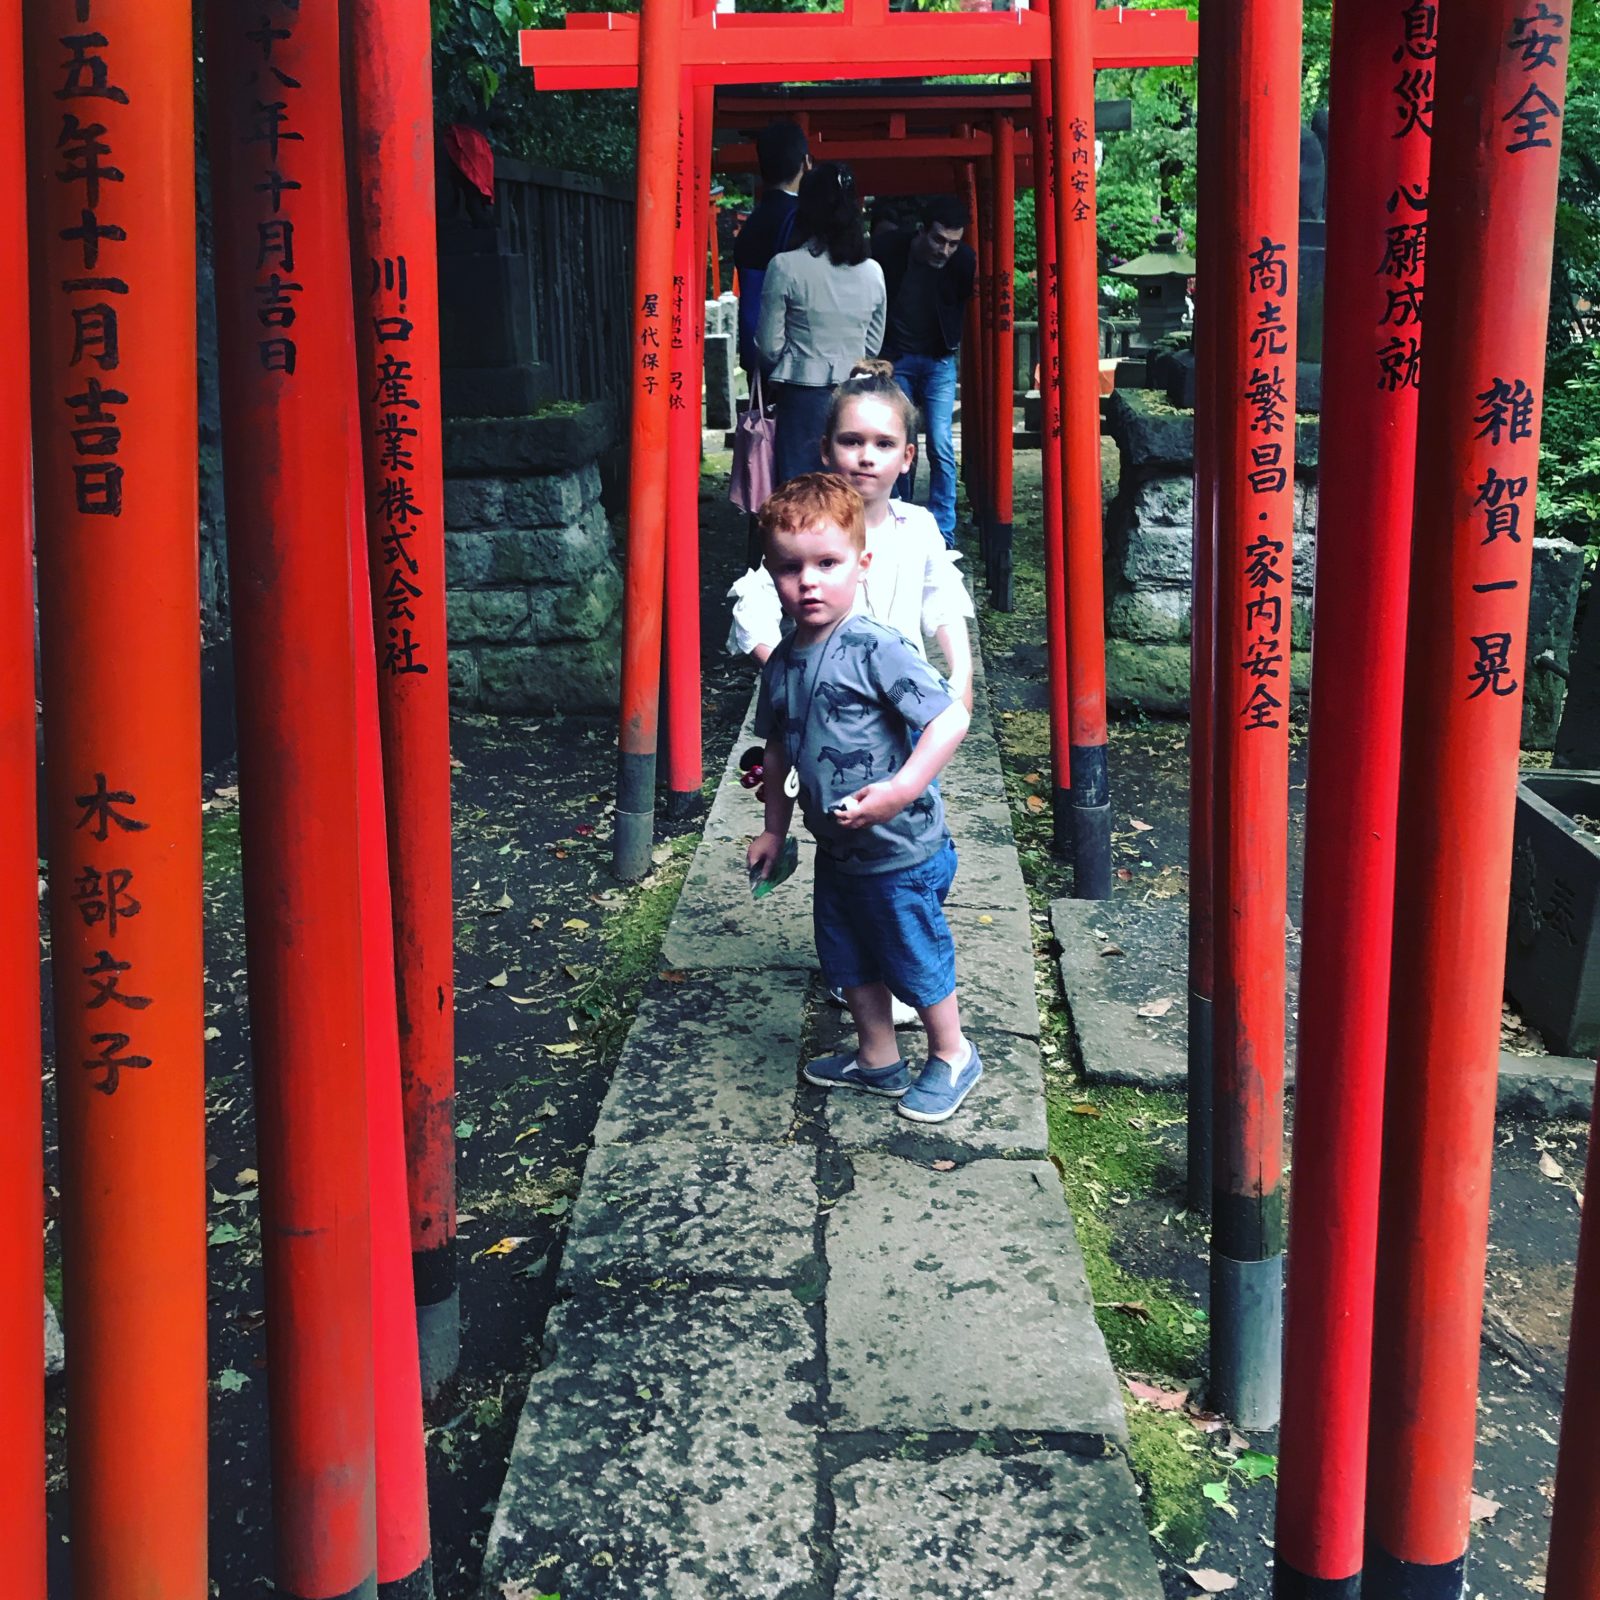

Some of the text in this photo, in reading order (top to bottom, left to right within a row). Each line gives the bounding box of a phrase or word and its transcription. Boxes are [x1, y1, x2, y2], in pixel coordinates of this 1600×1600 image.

[241, 0, 305, 375] 十八年十月吉日
[1069, 117, 1091, 222] 家内安全
[1501, 3, 1564, 154] 安全
[54, 0, 130, 516] 五年十一月吉日
[641, 293, 660, 395] 屋代保子
[1374, 182, 1429, 392] 心願成就
[370, 255, 429, 675] 川口産業株式会社
[1468, 378, 1533, 701] 雑賀一晃
[72, 773, 153, 1095] 木部文子
